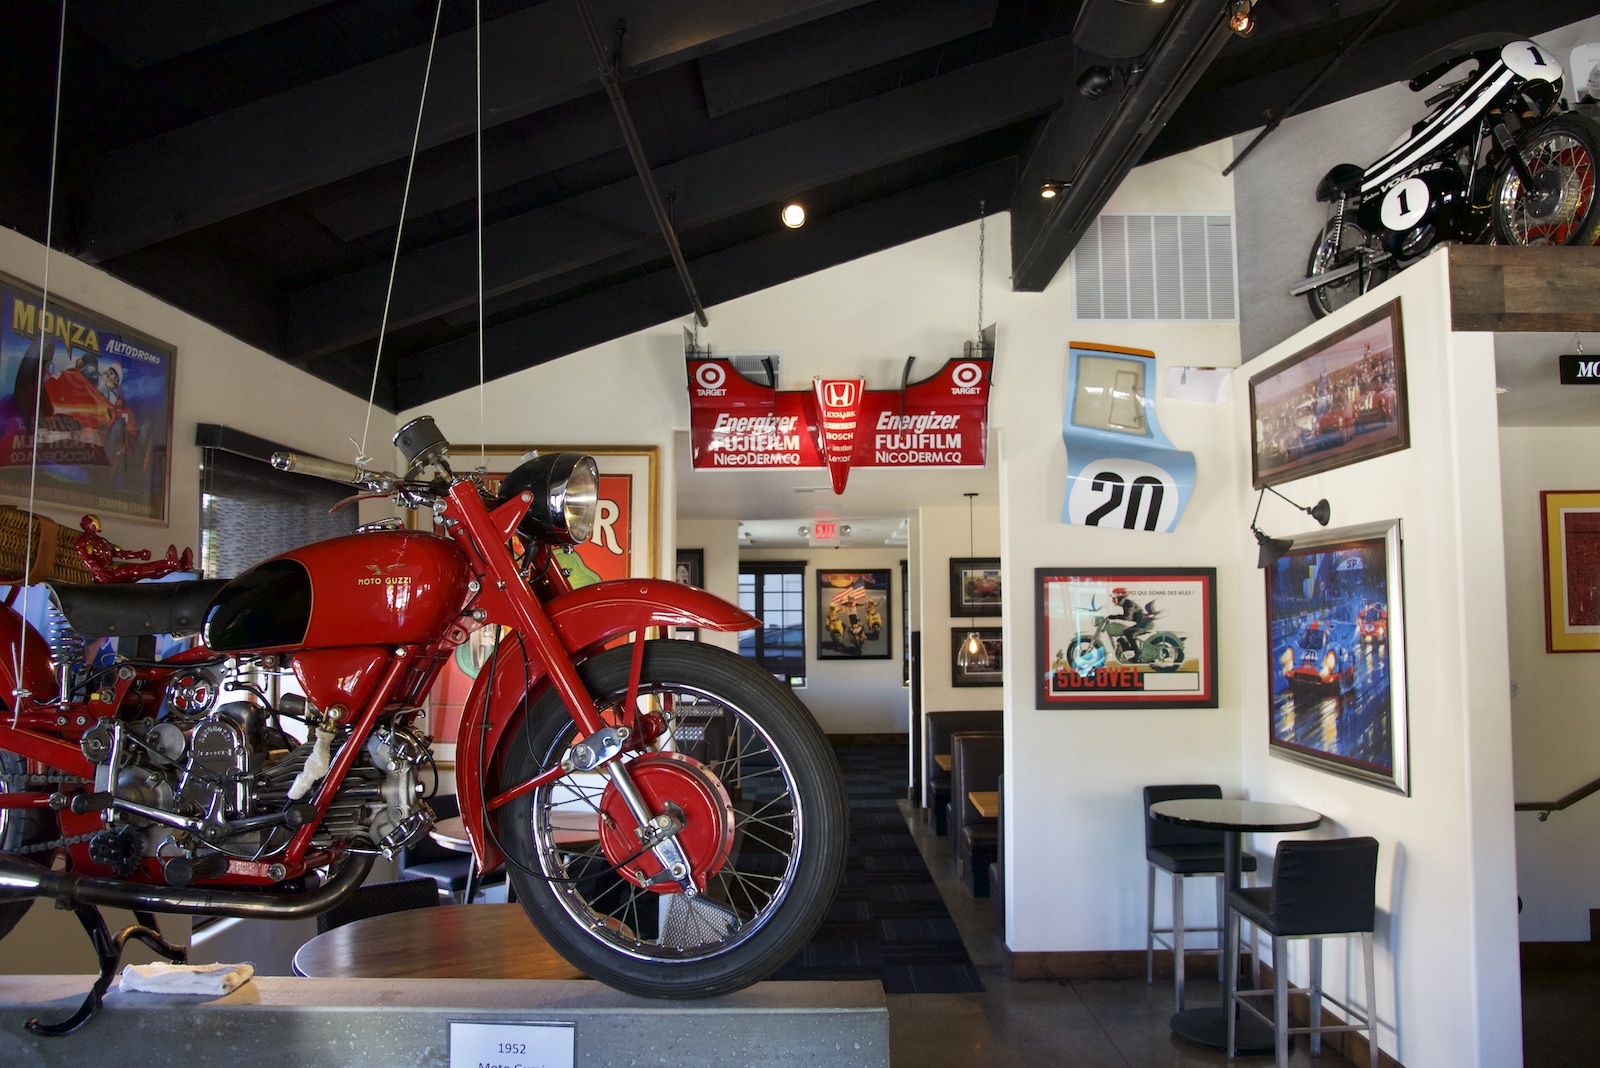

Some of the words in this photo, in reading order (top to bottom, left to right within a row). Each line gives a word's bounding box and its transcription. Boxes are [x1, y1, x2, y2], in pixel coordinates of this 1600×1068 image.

[1527, 46, 1547, 66] 1
[1380, 161, 1443, 193] VOLARE
[1397, 188, 1411, 217] 1
[13, 298, 100, 354] MONZA
[105, 339, 161, 365] AUTODROMO
[696, 388, 727, 397] TARGET
[951, 387, 981, 395] TARGET
[713, 412, 799, 435] Energizer
[824, 410, 856, 420] LEXMARK
[876, 411, 961, 434] Energizer
[713, 434, 800, 452] FUJIFILM
[826, 432, 854, 441] BOSCH
[875, 433, 962, 450] FUJIFILM
[1084, 471, 1164, 532] 20
[815, 523, 836, 539] EXIT
[358, 578, 382, 586] MOTO
[385, 576, 412, 585] GUZZI
[498, 1043, 526, 1054] 1952
